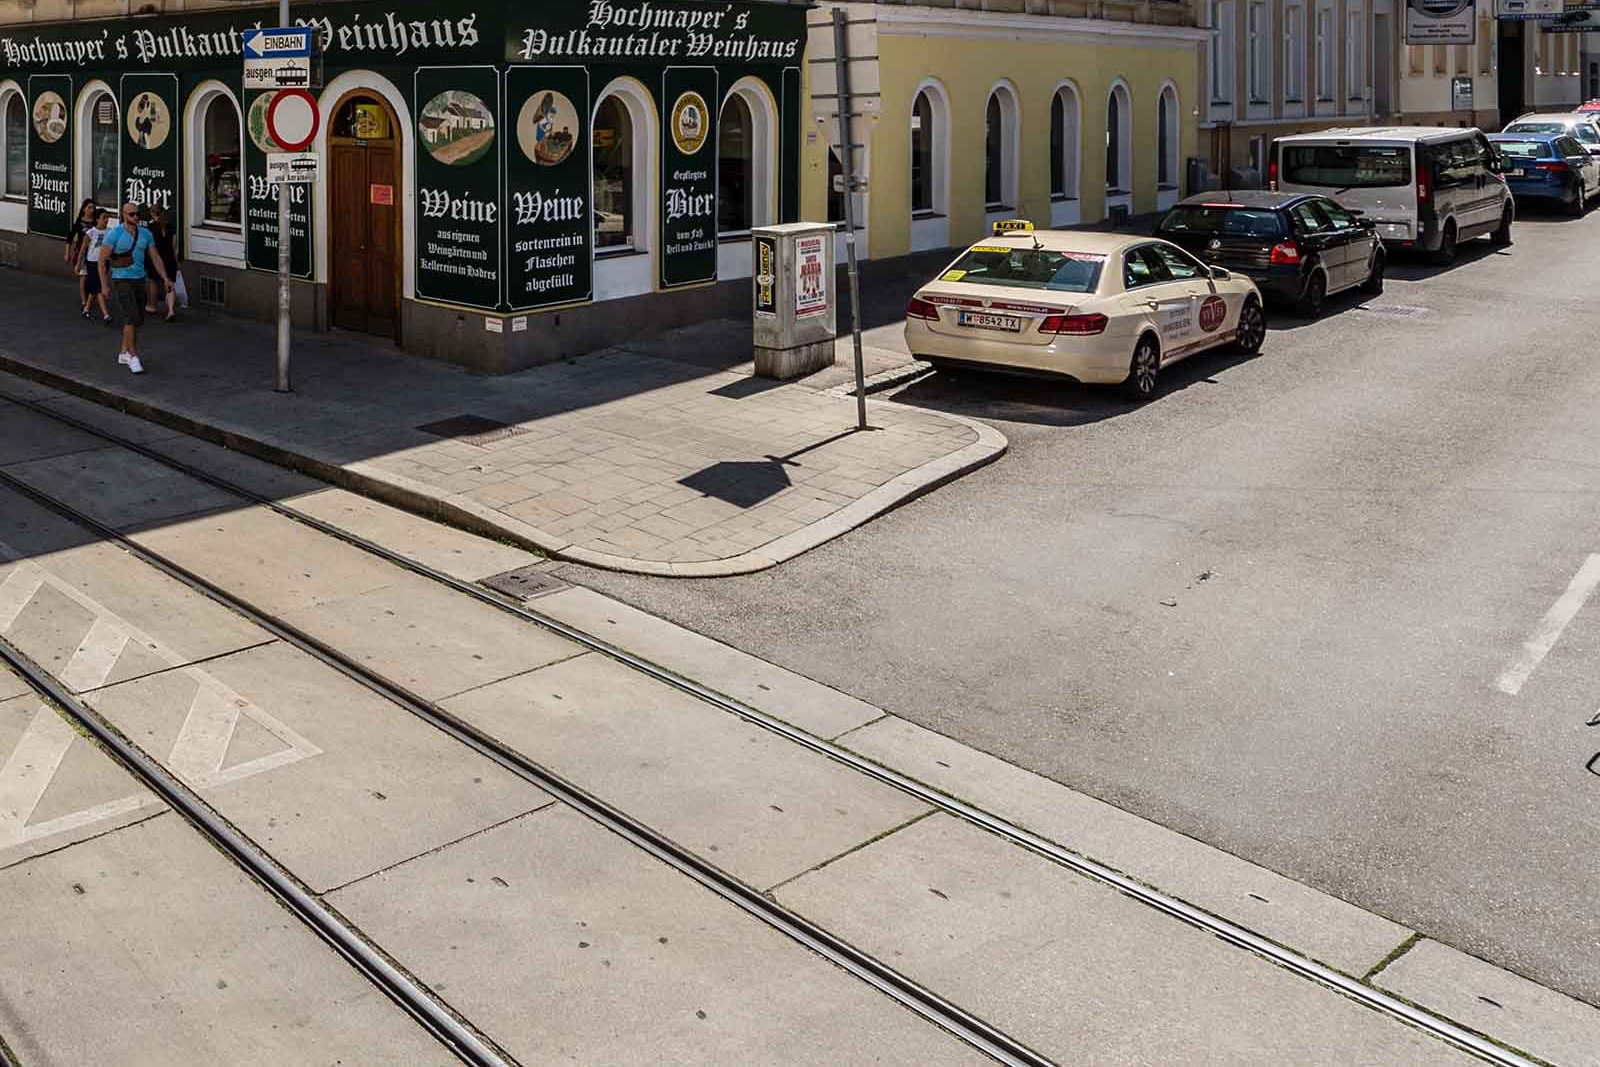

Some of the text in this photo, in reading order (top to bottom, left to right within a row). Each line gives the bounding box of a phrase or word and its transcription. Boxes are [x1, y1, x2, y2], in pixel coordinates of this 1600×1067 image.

[586, 0, 750, 32] Hochmayer's
[2, 28, 128, 67] Hochmayer's
[264, 36, 304, 50] EINBAHN
[519, 28, 799, 61] Pulkautaler Weinhaus
[246, 67, 275, 82] ausgen.
[31, 172, 70, 193] Wiener
[33, 193, 67, 214] Küche
[126, 178, 172, 211] Bier
[420, 188, 497, 223] Weine
[513, 188, 584, 225] Weine
[665, 186, 714, 224] Bier
[437, 229, 480, 244] aus eigenen
[515, 232, 584, 252] sortenrein in
[427, 242, 488, 261] Weingärten und
[458, 264, 466, 276] in
[524, 254, 576, 272] Flaschen
[526, 274, 574, 292] abgefüllt
[965, 314, 1016, 328] W 8542 TX
